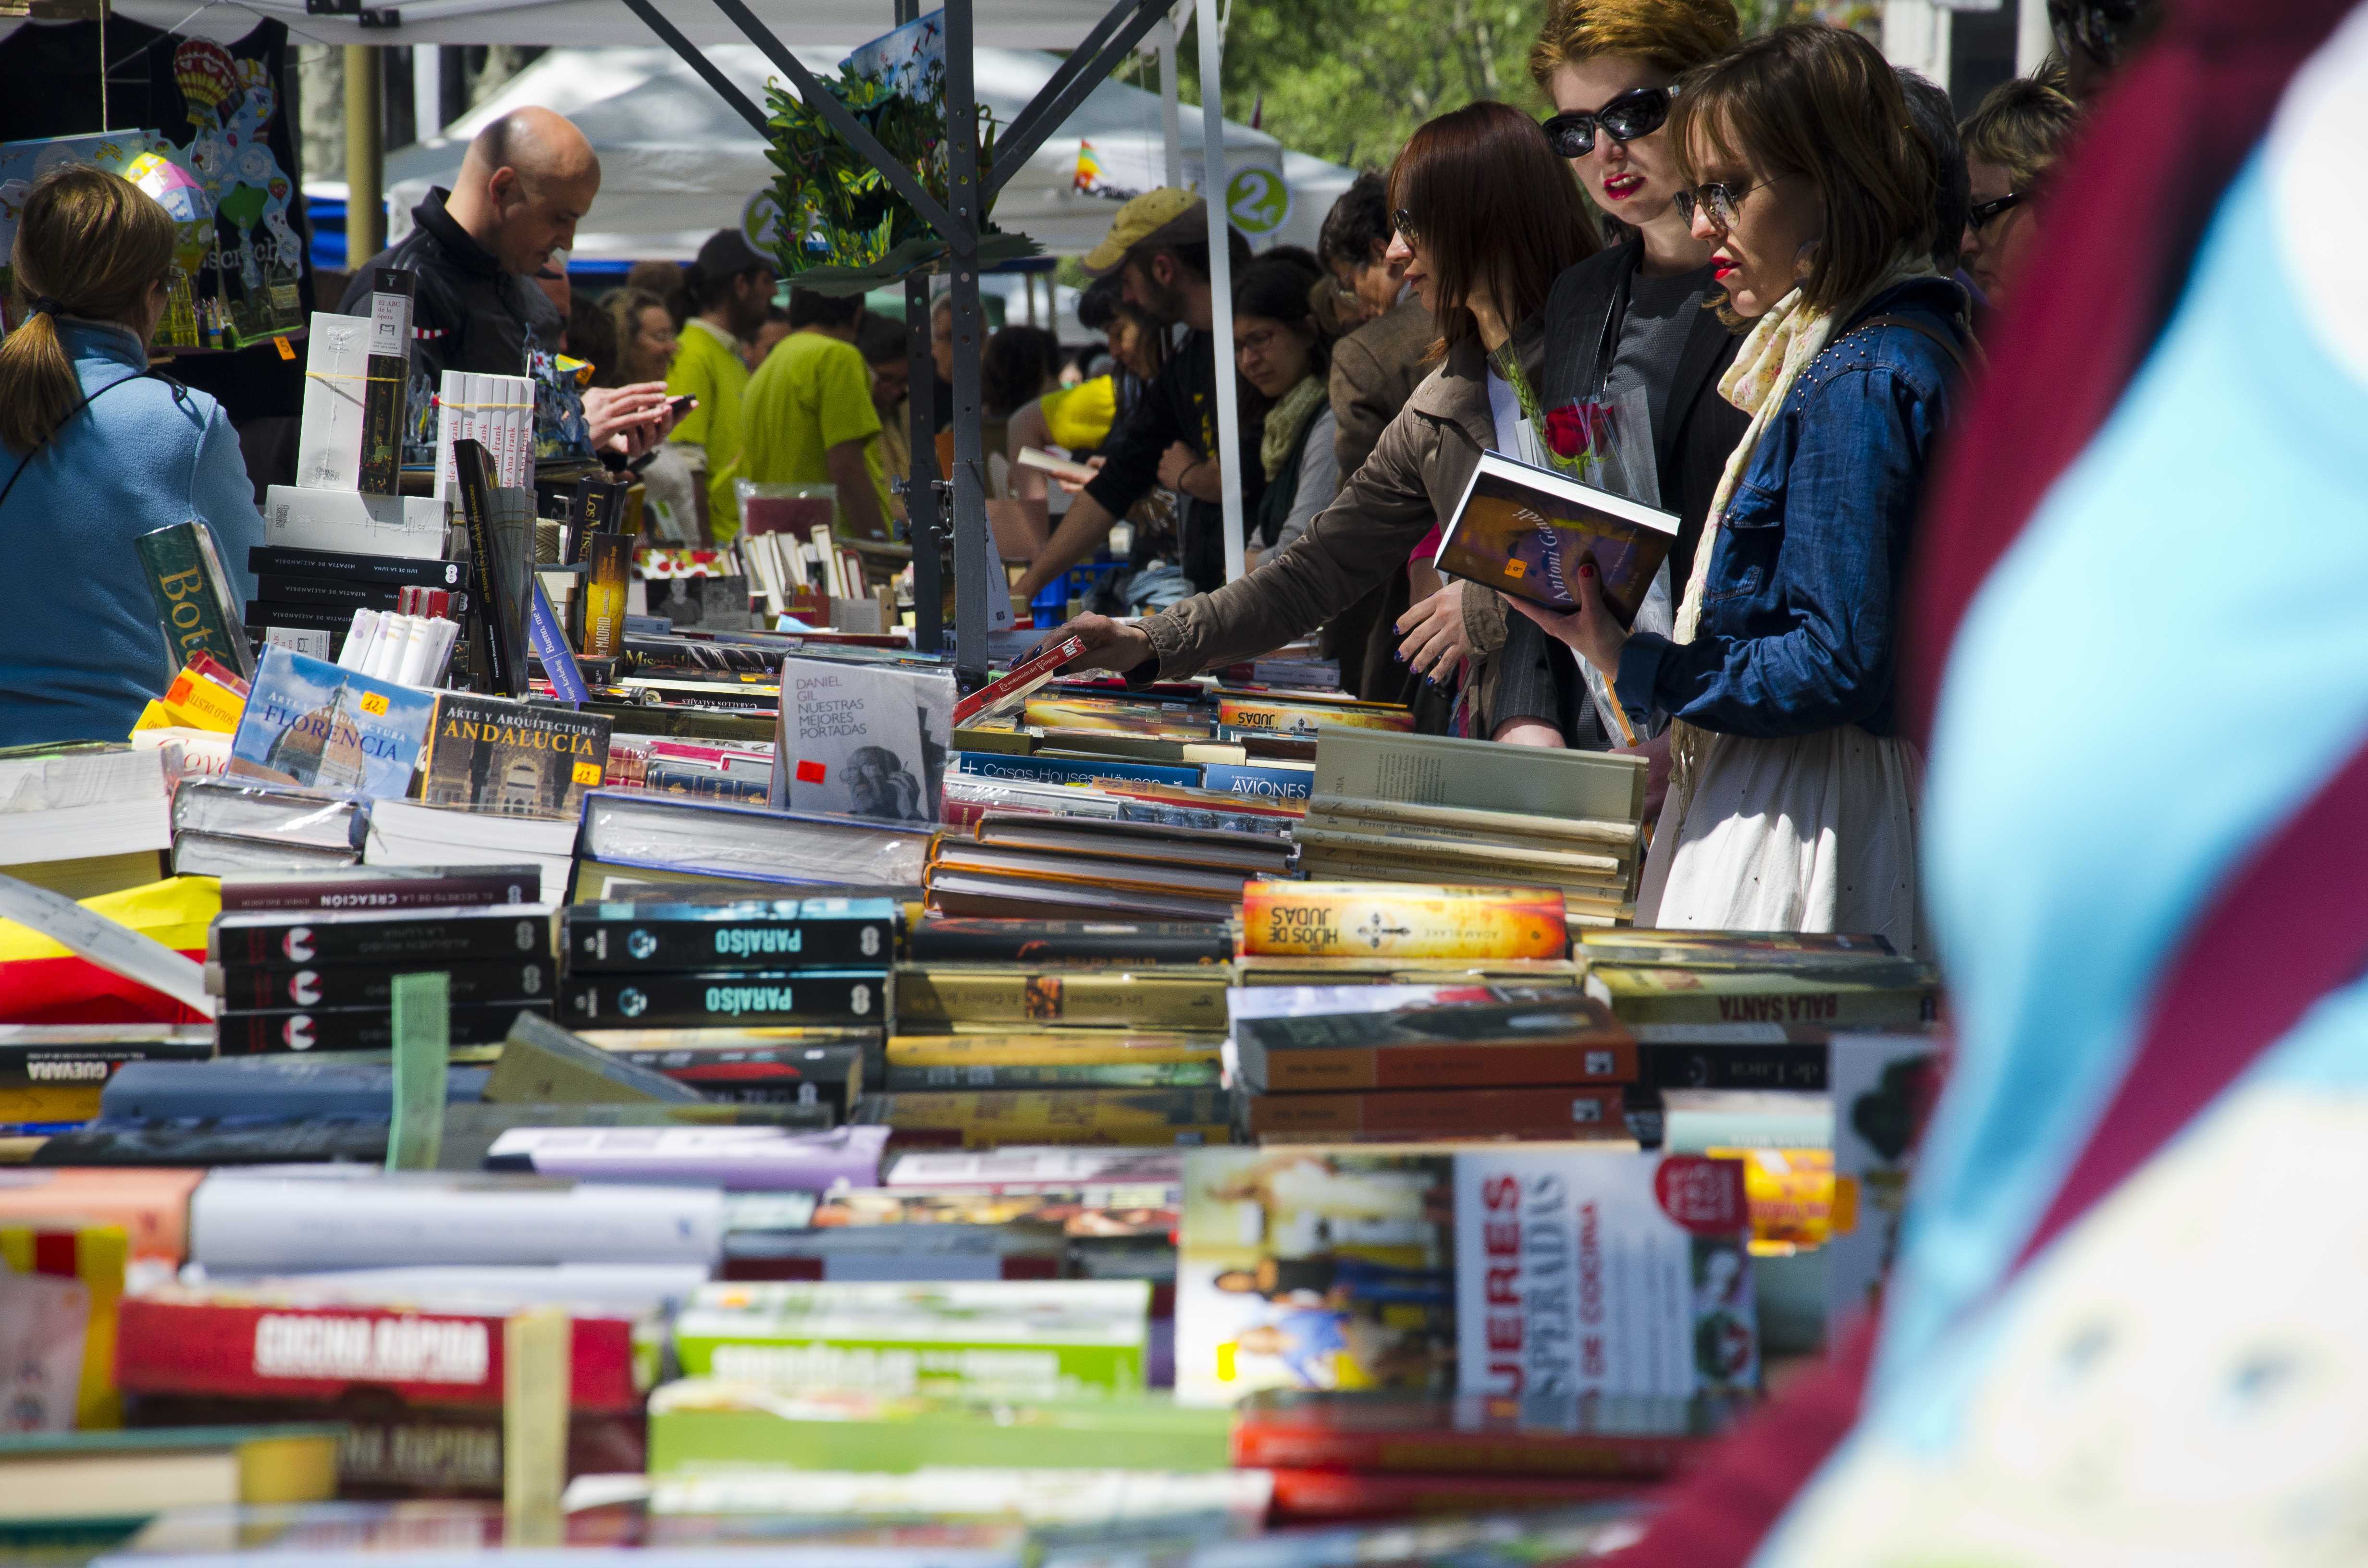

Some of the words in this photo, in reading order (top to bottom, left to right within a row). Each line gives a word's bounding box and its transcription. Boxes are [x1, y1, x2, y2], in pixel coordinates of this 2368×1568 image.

[465, 421, 473, 439] ank
[479, 424, 487, 445] rank
[493, 426, 501, 450] Frank
[506, 427, 516, 453] Frank
[520, 427, 529, 452] Frank
[447, 470, 455, 480] de
[504, 477, 512, 488] de
[469, 484, 479, 523] CIVILIZACIONES
[1512, 507, 1557, 547] Gaudí
[1542, 550, 1574, 602] Antoni
[533, 612, 543, 626] me
[540, 626, 555, 654] Bueno,
[595, 617, 612, 648] MADRID
[491, 660, 499, 678] Francesca
[555, 659, 570, 687] Kerkeling
[1007, 671, 1030, 686] seducción
[1036, 654, 1059, 671] Vampiro
[796, 676, 842, 690] DANIEL
[797, 691, 817, 702] GIL
[798, 698, 864, 714] NUESTRAS
[216, 708, 236, 726] SOLO
[268, 691, 301, 709] ARTE
[315, 708, 406, 742] ARQUITECTURA
[446, 707, 480, 720] ARTE
[485, 712, 493, 722] Y
[497, 713, 596, 736] ARQUITECTURA
[799, 712, 854, 728] MEJORES
[1237, 712, 1275, 725] JUDAS
[264, 705, 397, 761] FLORENCIA
[443, 720, 594, 756] ANDALUCÍA
[800, 723, 866, 739] PORTADAS
[984, 763, 1034, 779] Casas
[1231, 779, 1306, 799] AVIONES
[1358, 818, 1384, 830] Perros
[1387, 822, 1398, 831] de
[1400, 824, 1430, 835] guarda
[1440, 827, 1473, 838] defensa
[1345, 835, 1371, 845] Perros
[1387, 841, 1417, 851] guarda
[1426, 844, 1460, 854] defensa
[1498, 865, 1509, 873] de
[1512, 868, 1532, 877] agua
[321, 894, 397, 907] CREACIÓN
[1271, 907, 1332, 926] JUDAS
[715, 928, 802, 958] PARAÍSO
[1268, 926, 1287, 943] DE
[1293, 926, 1338, 944] HIJOS
[705, 986, 792, 1017] PARAÍSO
[1717, 994, 1784, 1021] SANTA
[1786, 992, 1838, 1019] BALA
[27, 1061, 108, 1081] GUEVARA
